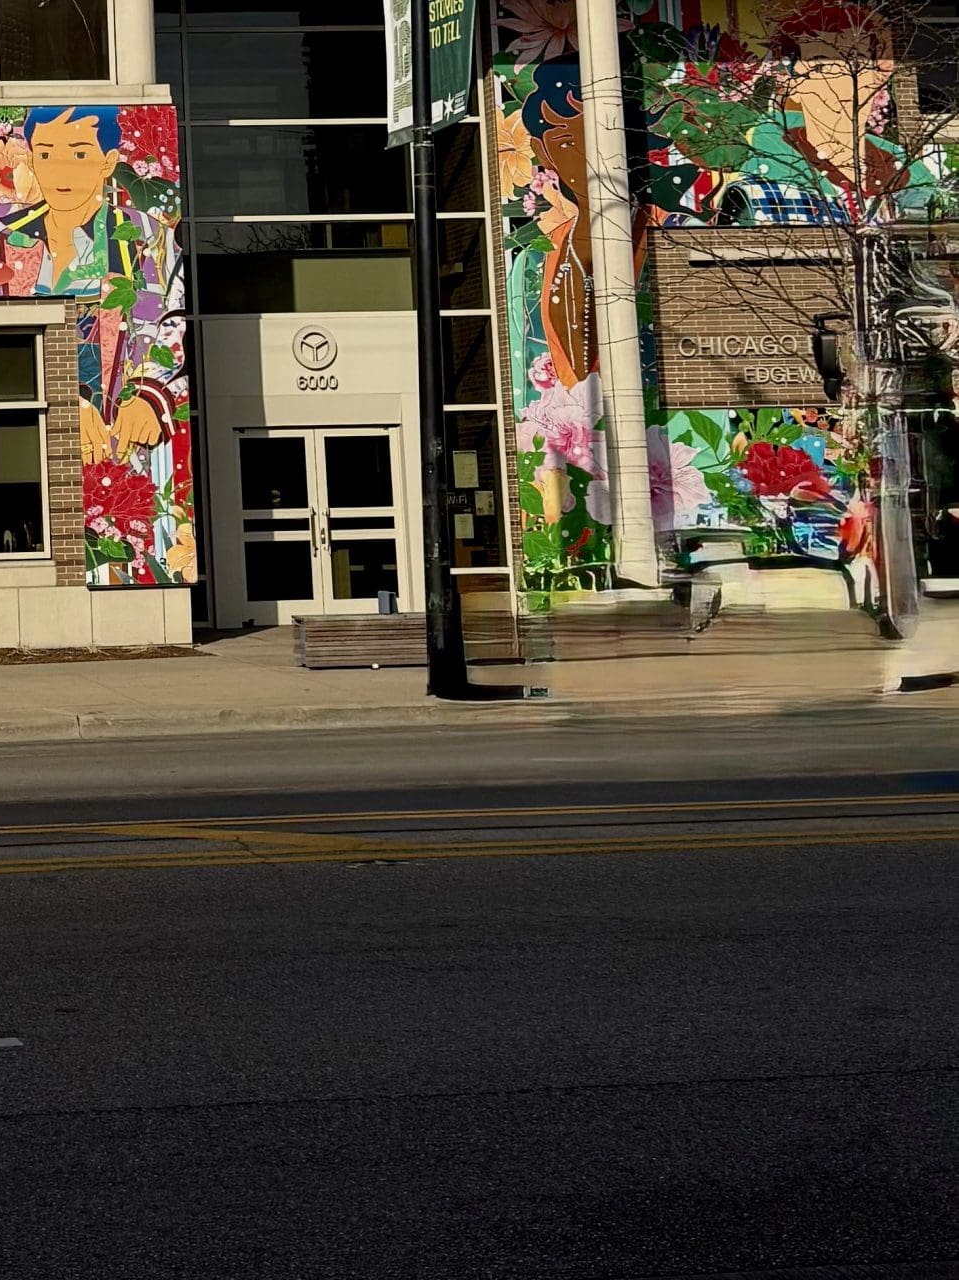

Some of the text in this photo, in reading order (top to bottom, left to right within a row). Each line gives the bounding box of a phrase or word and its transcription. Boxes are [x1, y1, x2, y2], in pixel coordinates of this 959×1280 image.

[429, 19, 461, 49] TO TELL
[678, 334, 798, 357] CHICAGO
[296, 375, 339, 391] 6000
[743, 366, 822, 385] EDGEW
